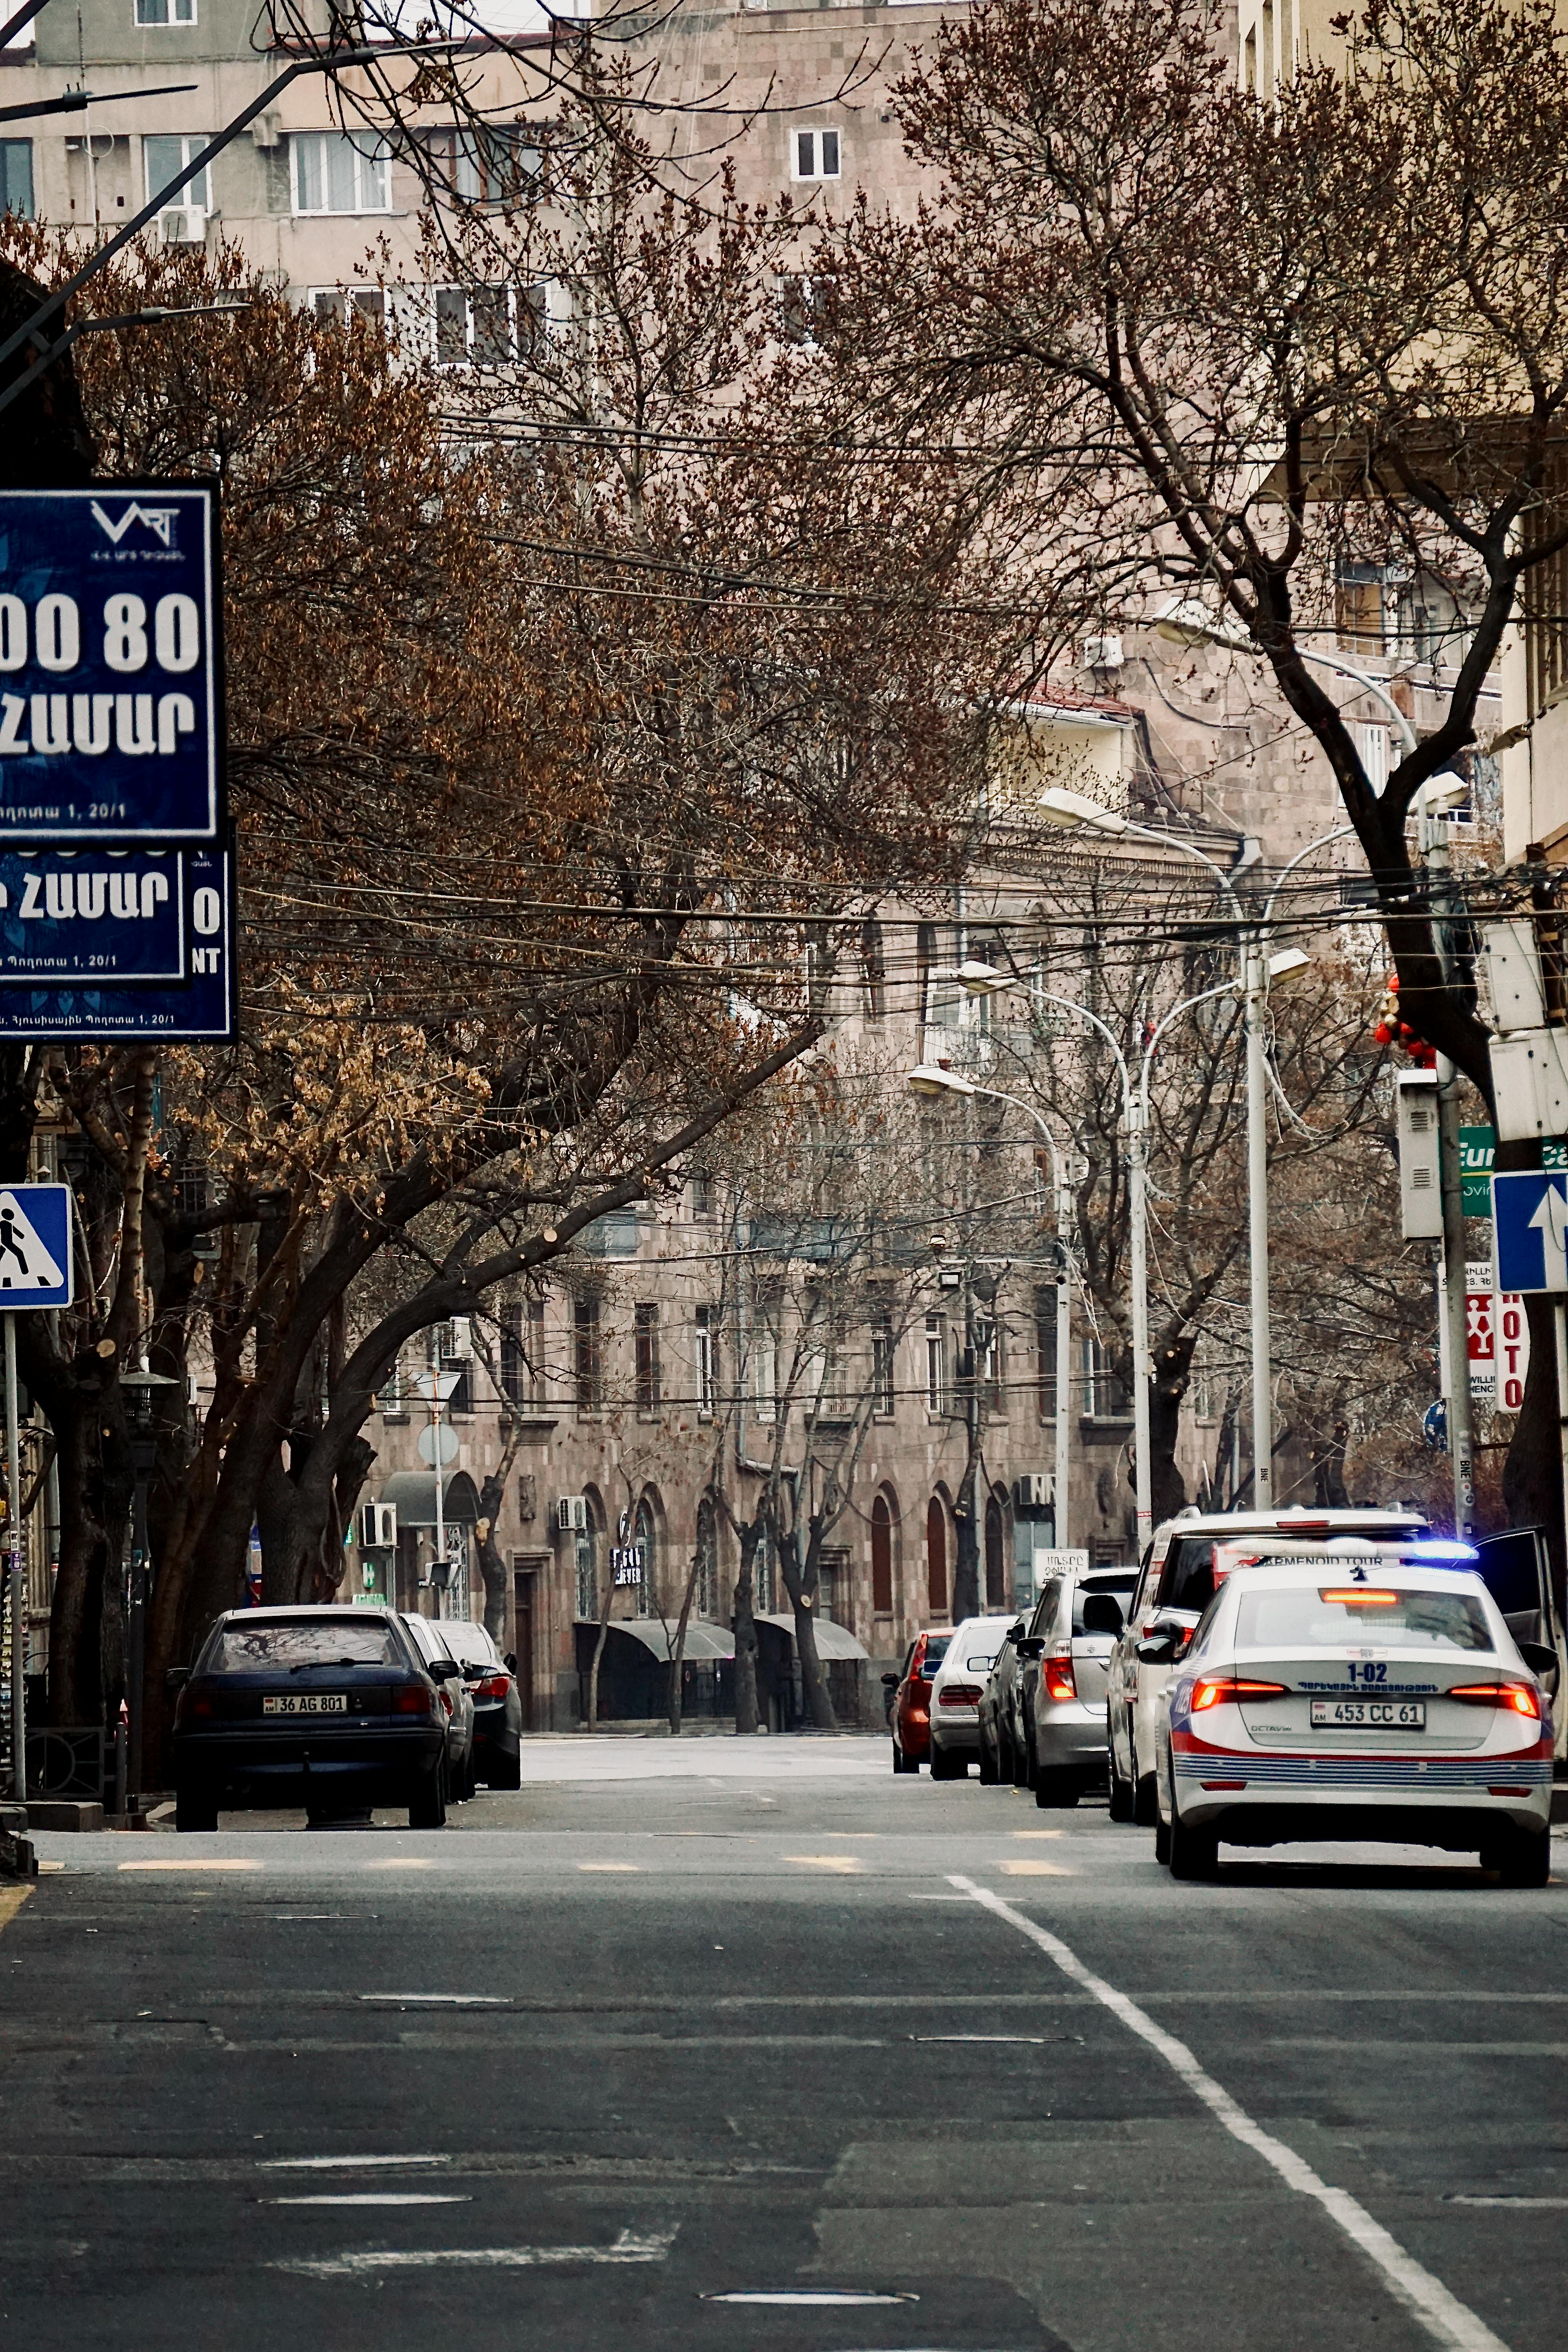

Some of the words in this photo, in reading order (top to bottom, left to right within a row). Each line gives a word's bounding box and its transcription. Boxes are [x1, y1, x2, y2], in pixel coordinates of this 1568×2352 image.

[103, 593, 200, 673] 80
[88, 802, 125, 820] 20/1
[89, 955, 117, 967] 20/1
[152, 1015, 174, 1024] 20/1
[1348, 1663, 1387, 1682] 1-02
[280, 1698, 295, 1711] 36
[299, 1698, 316, 1711] AG
[321, 1697, 343, 1711] 801
[1335, 1704, 1364, 1722] 453
[1370, 1705, 1394, 1722] CC
[1399, 1705, 1419, 1722] 61
